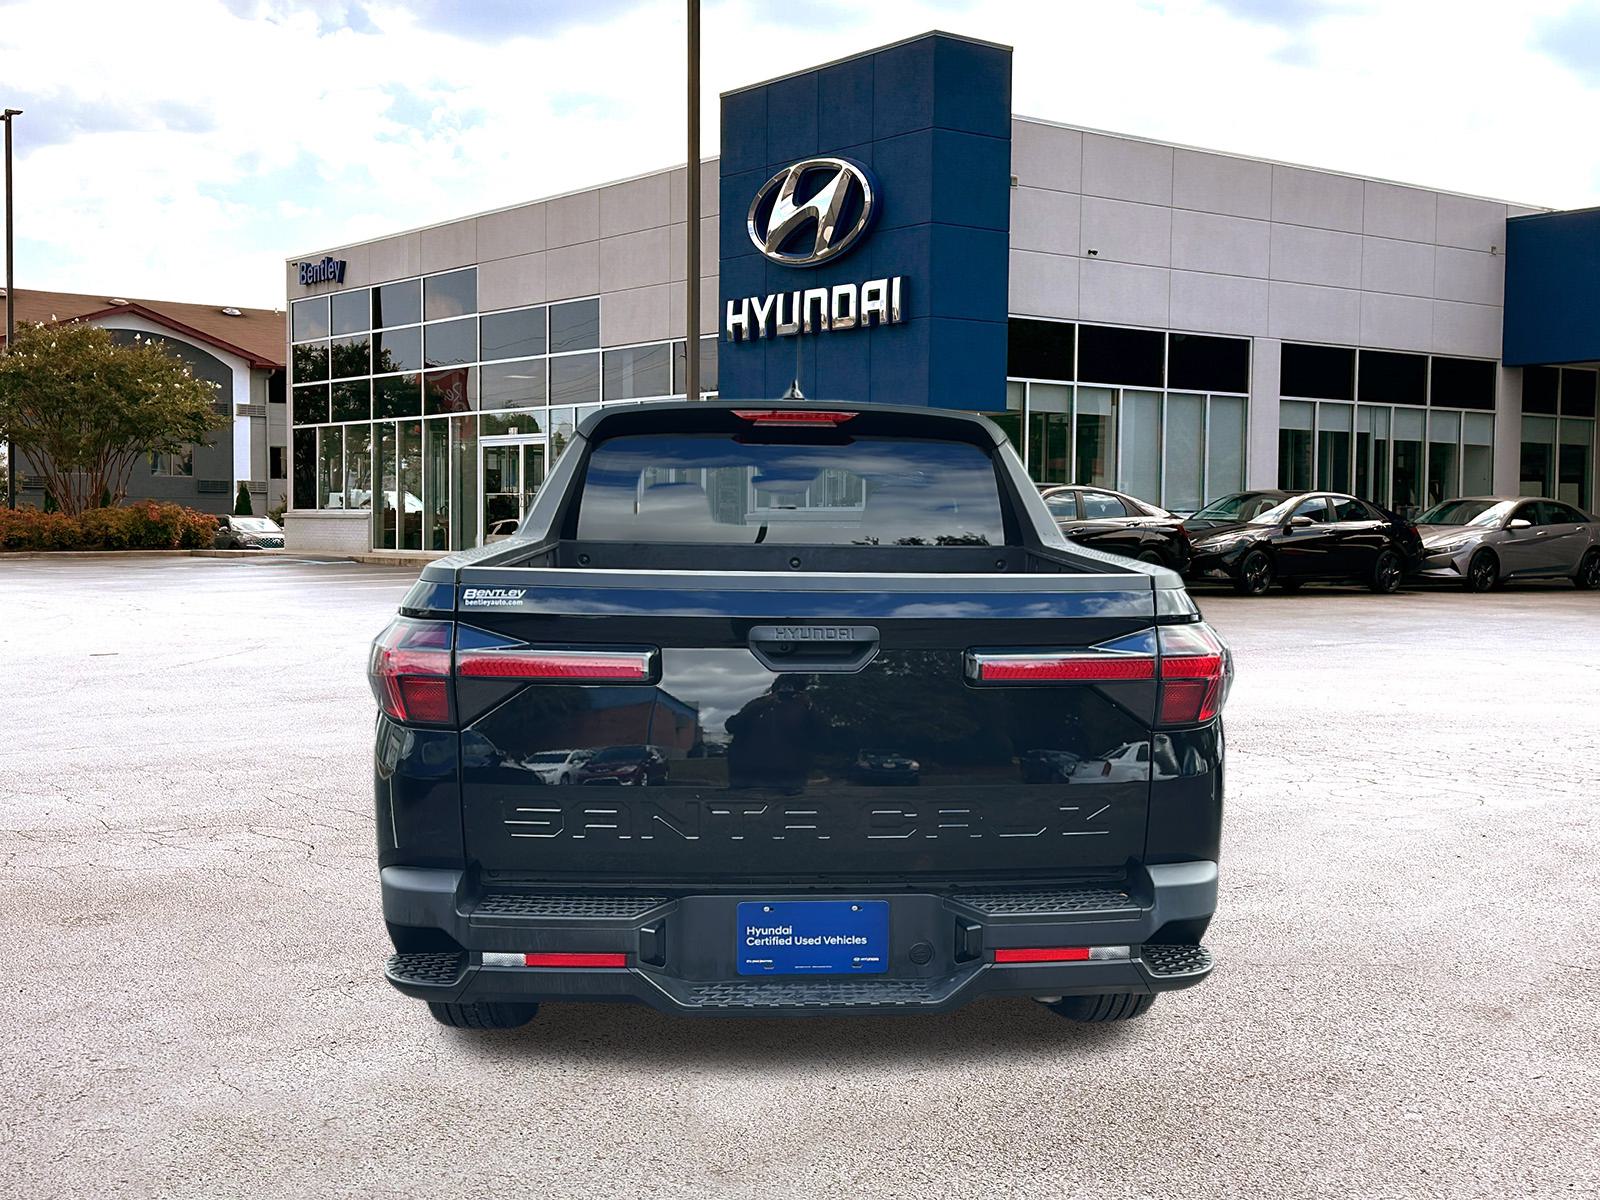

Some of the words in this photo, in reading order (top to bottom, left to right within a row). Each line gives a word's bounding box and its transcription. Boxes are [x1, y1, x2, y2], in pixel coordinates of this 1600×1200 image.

[299, 256, 346, 286] Bentley
[727, 276, 902, 342] HYUNDAI
[464, 599, 524, 607] bentleyauto.com
[774, 626, 856, 641] HYUNDAI
[503, 802, 832, 840] SANTA
[862, 802, 1112, 840] CRUZ
[746, 925, 793, 937] Hyundai
[746, 936, 793, 946] Certified
[794, 936, 822, 945] Used
[823, 935, 868, 945] Vehicles
